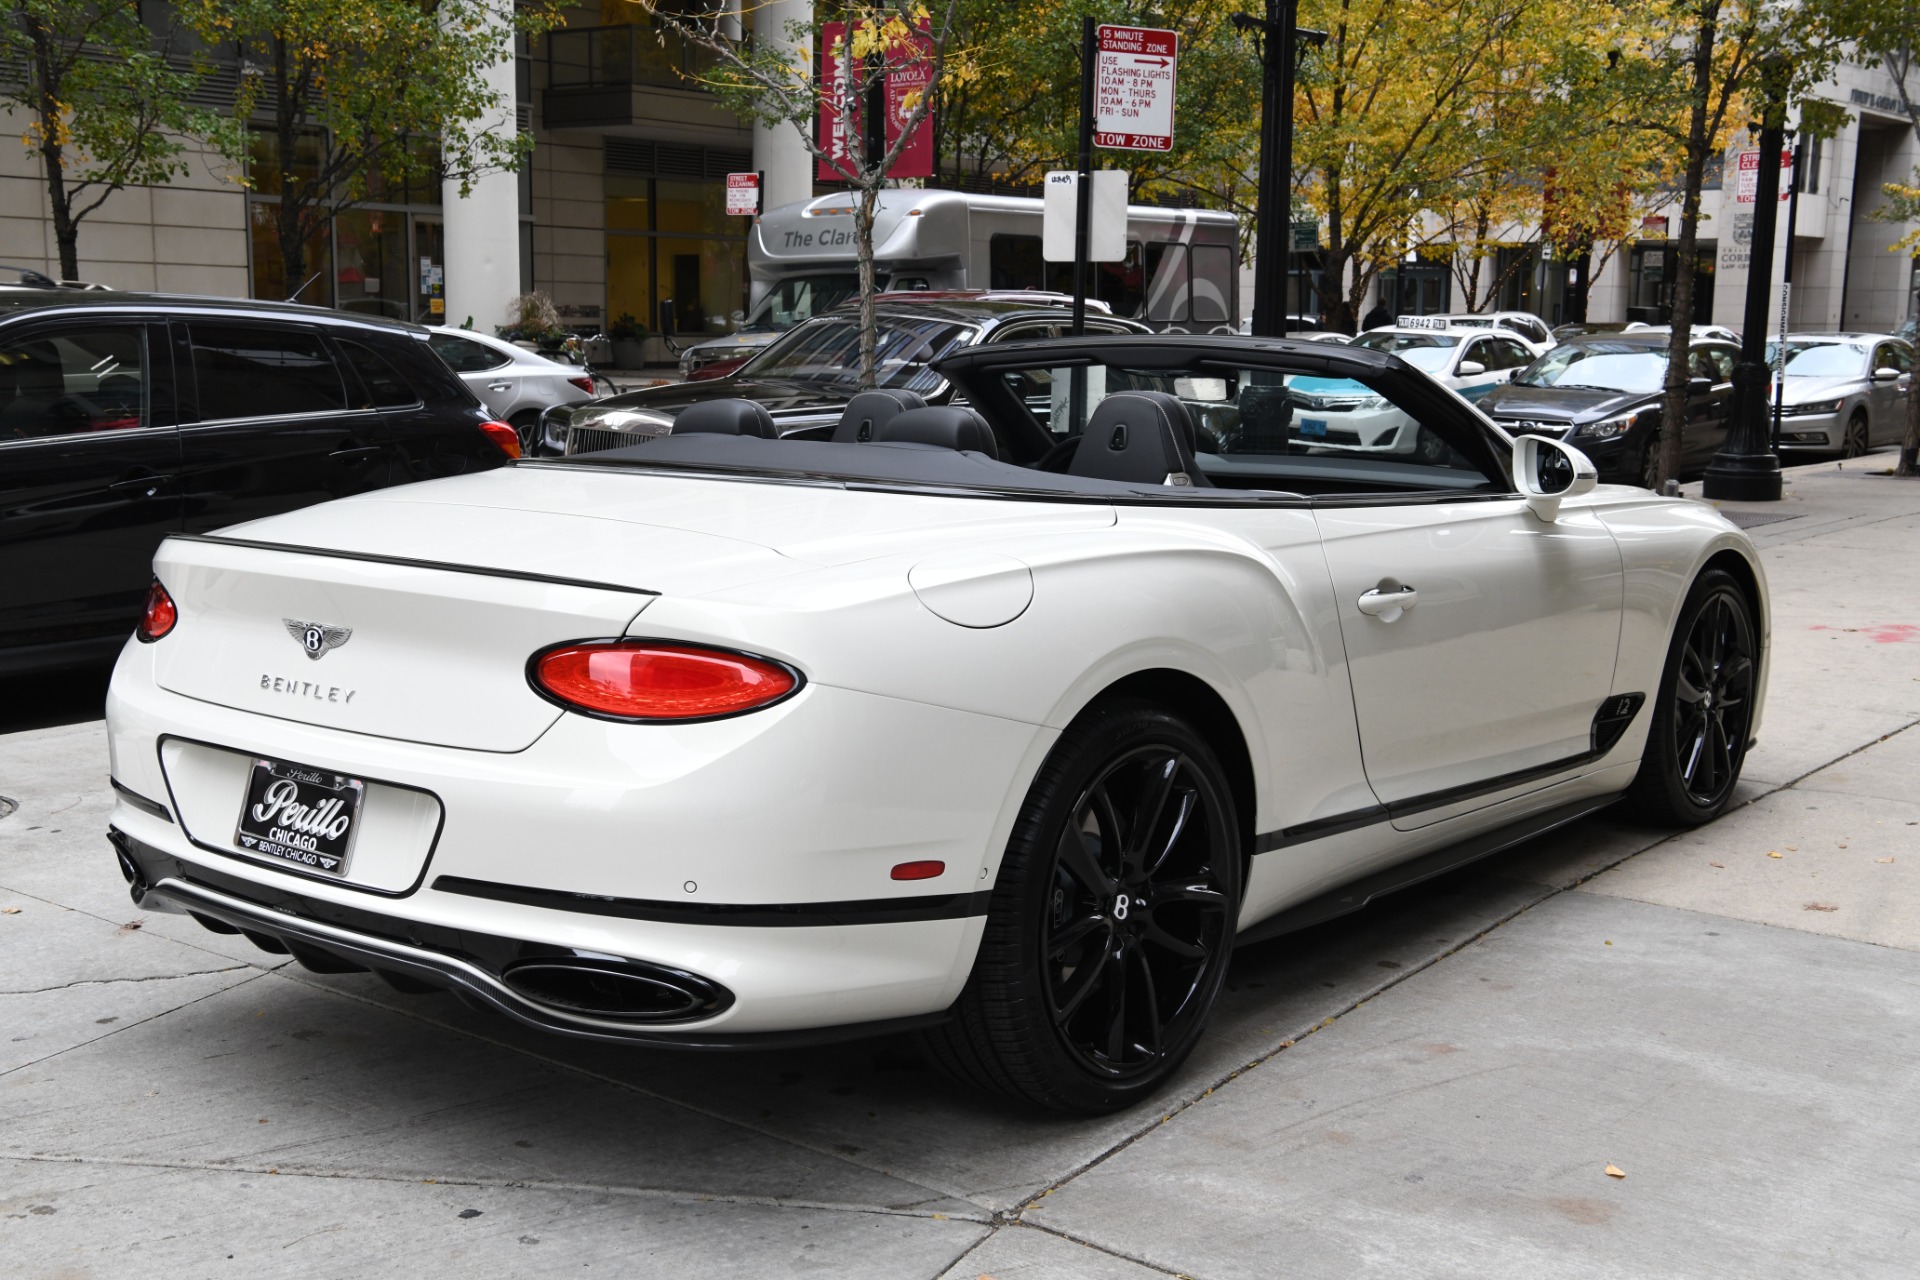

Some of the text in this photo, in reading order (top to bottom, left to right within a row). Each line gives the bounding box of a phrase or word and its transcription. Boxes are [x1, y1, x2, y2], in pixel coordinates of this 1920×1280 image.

[1103, 29, 1144, 42] 15 MINUTE
[1102, 40, 1168, 54] STANDING ZONE
[1102, 56, 1118, 65] USE
[890, 71, 926, 82] LOYOLA
[1102, 66, 1170, 80] FLASHING LIGHTS
[1102, 76, 1110, 84] 10
[1112, 78, 1124, 86] AM
[1132, 78, 1138, 87] 8
[1140, 80, 1153, 88] PM
[1100, 86, 1118, 96] MON
[1128, 88, 1156, 98] THURS
[832, 58, 846, 160] WELCOM
[1100, 96, 1108, 104] 10
[1110, 97, 1122, 106] AM
[1131, 99, 1137, 108] 6
[1138, 100, 1151, 108] PM
[1100, 106, 1114, 116] FRI
[1122, 108, 1139, 118] SUN
[1100, 133, 1165, 148] TOW ZONE
[784, 230, 812, 248] The
[1721, 254, 1750, 262] CORB
[1780, 284, 1788, 345] CONSIGNMENT
[1410, 318, 1430, 328] 6942
[260, 674, 356, 704] BENTLEY
[1616, 698, 1631, 716] 12
[286, 768, 323, 784] Perillo
[252, 779, 350, 840] Perillo
[268, 827, 318, 851] CHICAGO
[258, 840, 317, 865] BENTLEY CHICAGO
